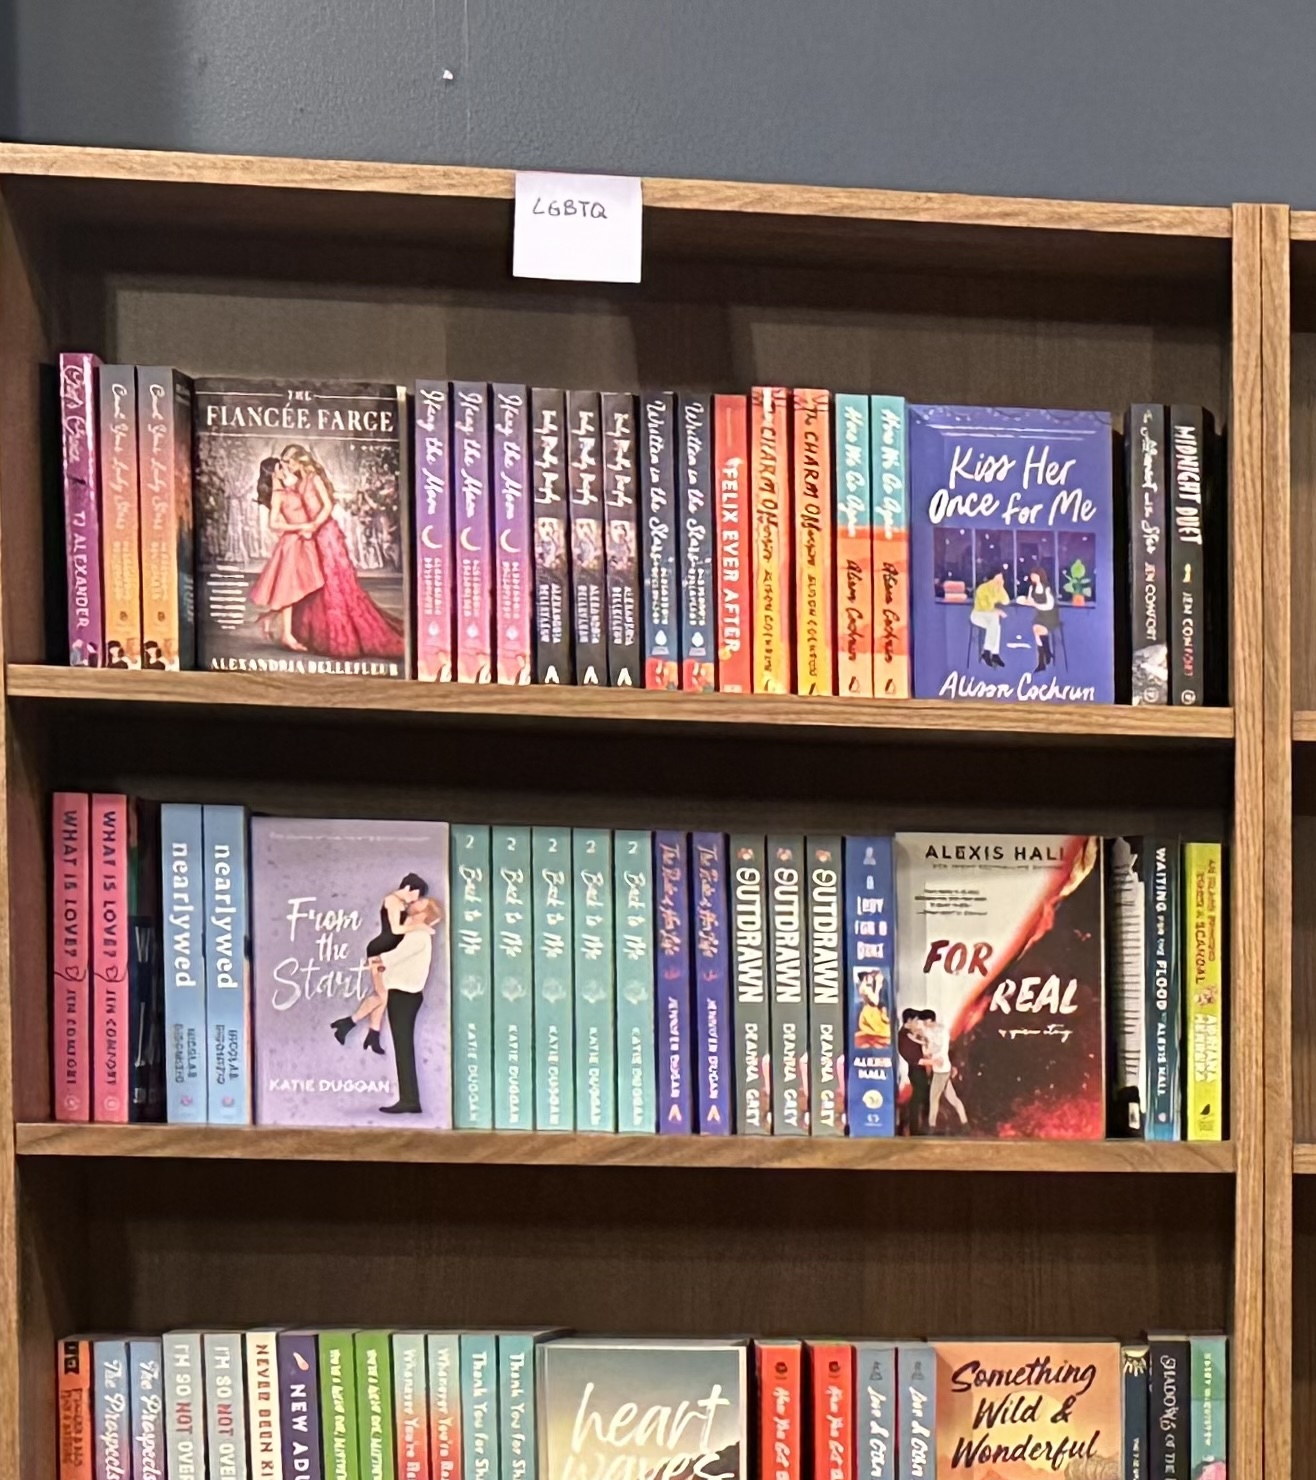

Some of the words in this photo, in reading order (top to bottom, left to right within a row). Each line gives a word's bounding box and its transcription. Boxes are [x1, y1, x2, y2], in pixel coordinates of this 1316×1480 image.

[532, 197, 608, 219] LGBTQ
[206, 401, 311, 429] FIANCÉE
[802, 431, 819, 498] CHARM
[949, 446, 1017, 489] Kiss
[1023, 445, 1076, 489] Her
[1174, 425, 1201, 504] MIDNIGHT
[720, 466, 739, 522] FELIX
[929, 489, 1000, 524] Once
[1002, 503, 1043, 525] for
[1048, 488, 1096, 525] Me
[1176, 507, 1202, 545] DUET
[723, 530, 739, 582] EVER
[72, 533, 90, 629] ALEXANDER
[723, 588, 741, 652] AFTER
[210, 657, 306, 674] ALEXANDRIA
[939, 670, 1013, 699] Alison
[1017, 671, 1095, 700] Cochrun
[63, 810, 78, 867] WHAT
[103, 811, 117, 868] WHAT
[925, 845, 1004, 861] ALEXIS
[63, 872, 77, 890] IS
[103, 873, 117, 891] IS
[1155, 848, 1167, 912] WAITING
[63, 900, 78, 958] LOVE?
[103, 901, 117, 957] LOVE?
[169, 843, 196, 987] nearlywed
[211, 845, 238, 988] nearlywed
[286, 897, 361, 941] From
[736, 867, 764, 1003] OUTDRAWN
[774, 867, 801, 1003] OUTDRAWN
[315, 935, 348, 961] the
[923, 939, 993, 976] FOR
[272, 958, 373, 1011] Start
[989, 975, 1079, 1015] REAL
[1155, 960, 1167, 1010] FLOOD
[269, 1078, 314, 1091] KATIE
[176, 1373, 192, 1396] SO
[216, 1375, 232, 1397] SO
[256, 1344, 271, 1401] NEVER
[472, 1351, 487, 1397] Thank
[951, 1355, 1097, 1396] Something
[176, 1402, 193, 1434] NOT
[217, 1403, 233, 1437] NOT
[290, 1384, 307, 1433] NEW
[473, 1401, 488, 1429] You
[571, 1381, 730, 1452] heart
[972, 1394, 1043, 1430] Wild
[1050, 1395, 1078, 1424] &
[99, 1393, 126, 1480] Prospects
[259, 1409, 272, 1453] BEEN
[475, 1433, 489, 1454] for
[951, 1430, 1100, 1471] Wonderful
